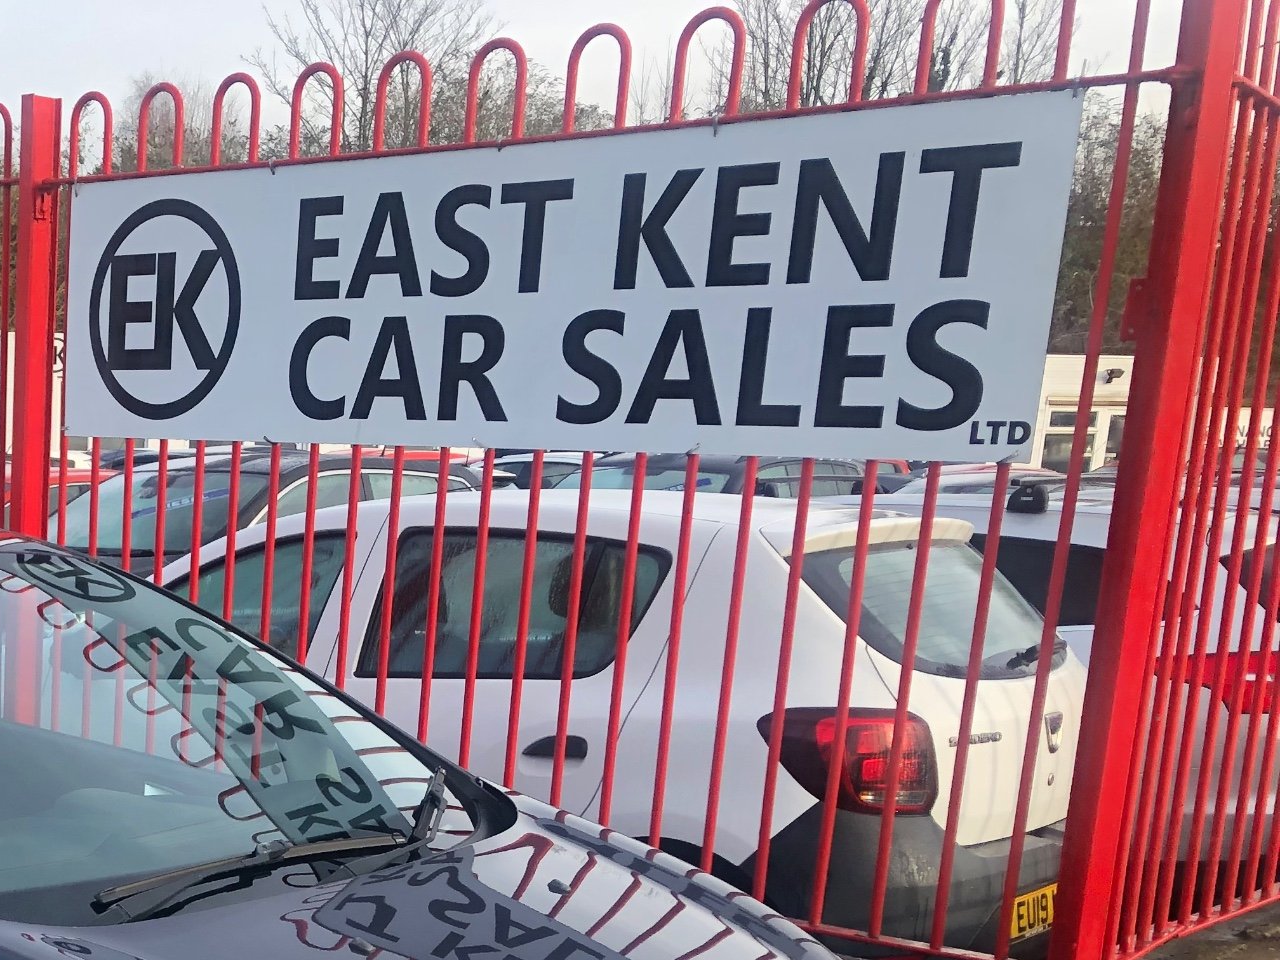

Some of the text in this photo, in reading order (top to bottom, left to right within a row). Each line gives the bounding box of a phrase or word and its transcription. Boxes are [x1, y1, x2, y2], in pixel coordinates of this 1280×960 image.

[292, 141, 1022, 300] EAST KENT
[108, 248, 223, 371] EK
[289, 300, 990, 432] CAR SALES
[968, 420, 1031, 445] LTD
